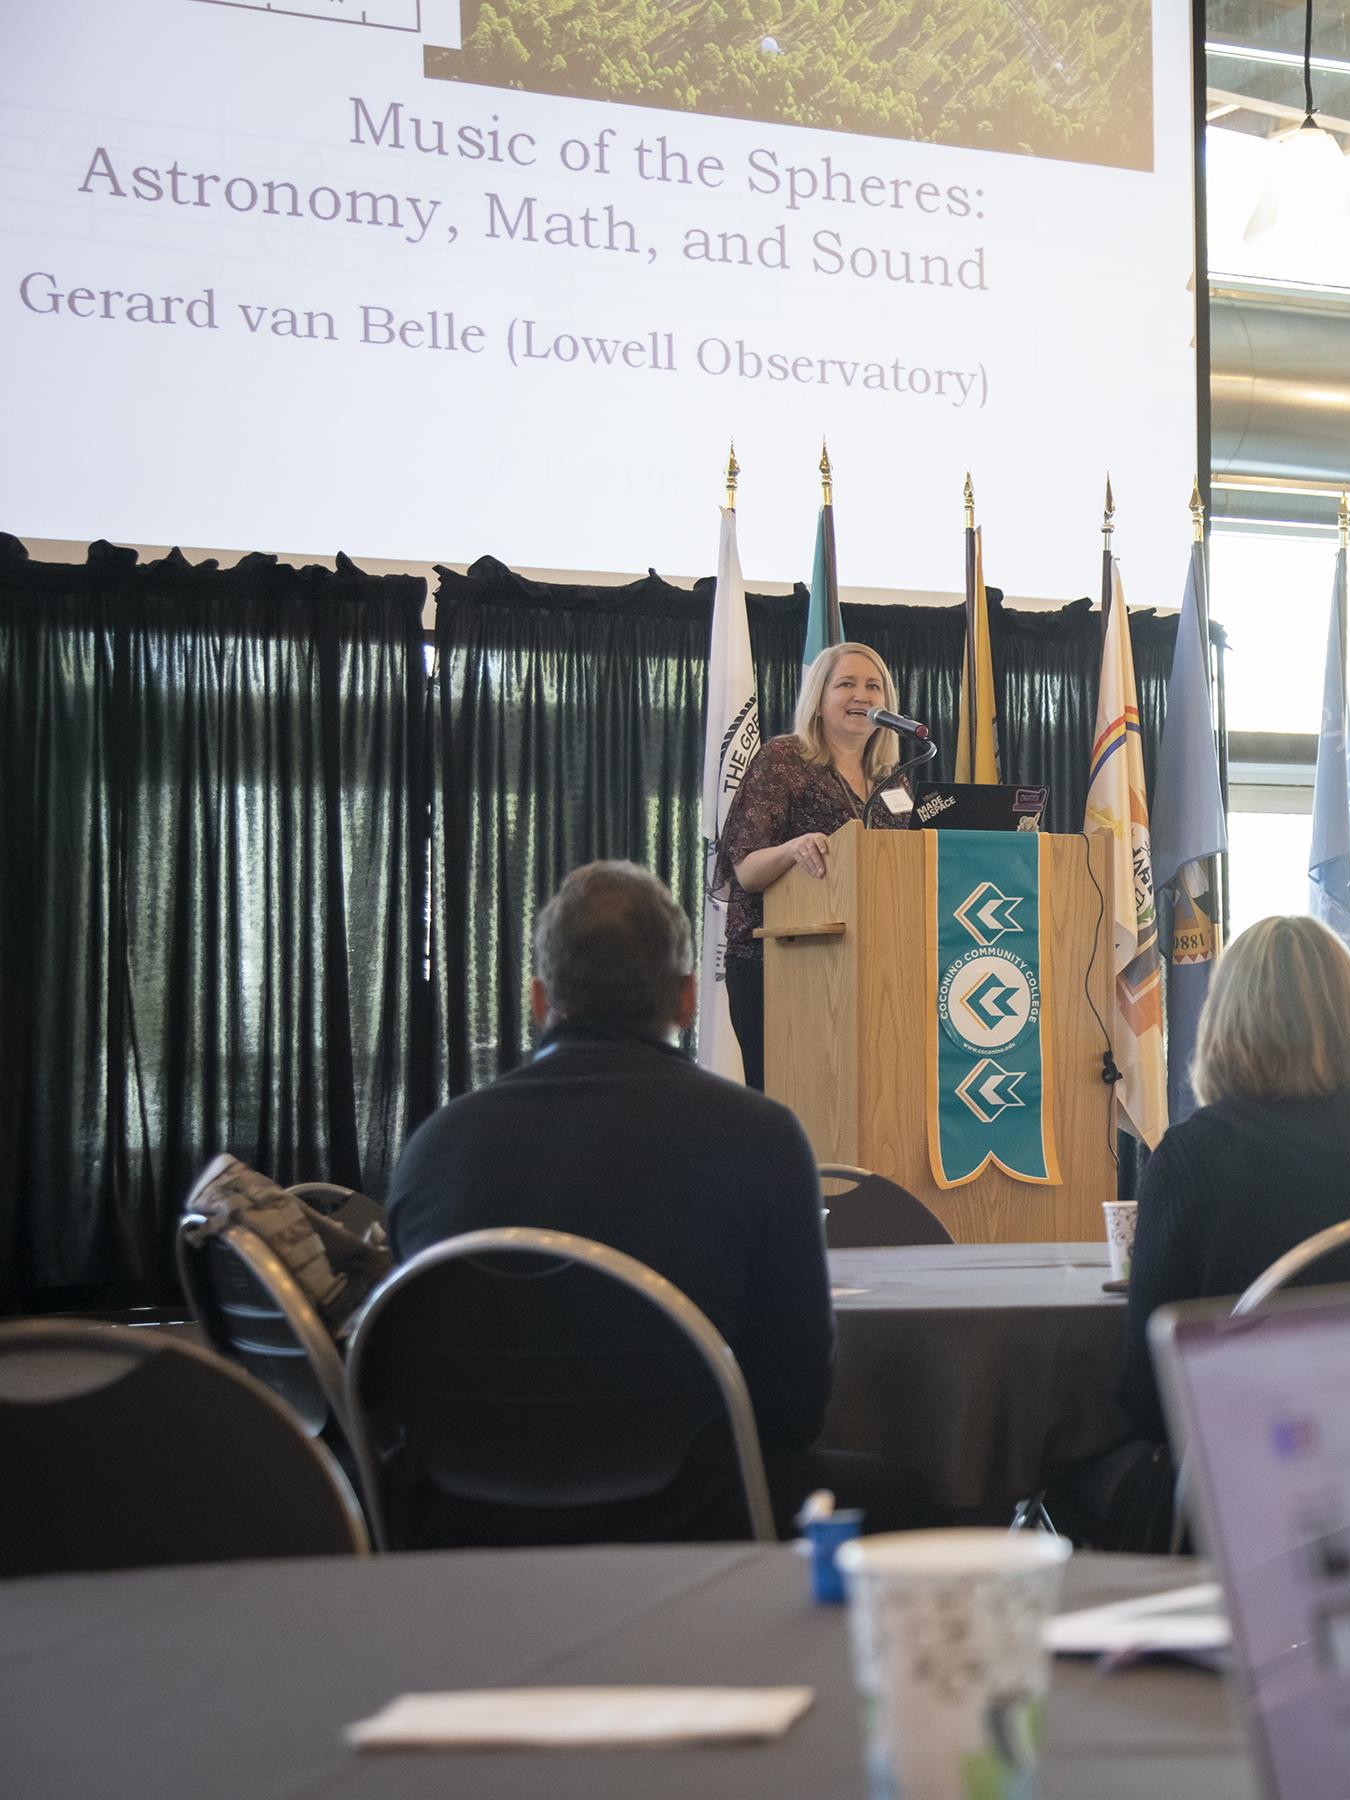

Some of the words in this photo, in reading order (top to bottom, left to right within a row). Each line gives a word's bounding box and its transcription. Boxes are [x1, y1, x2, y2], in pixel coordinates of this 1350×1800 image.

[349, 96, 537, 166] Music
[560, 129, 617, 175] of
[634, 136, 724, 188] the
[748, 148, 985, 219] Spheres:
[77, 147, 459, 243] Astronomy,
[484, 192, 657, 264] Math,
[683, 224, 790, 269] and
[812, 230, 989, 290] Sound
[19, 272, 219, 329] Gerard
[238, 304, 338, 340] van
[359, 305, 486, 353] Belle
[507, 318, 677, 371] (Lowell
[697, 337, 989, 408] Observatory)
[723, 750, 746, 793] THE
[917, 795, 943, 816] MADE
[930, 796, 957, 818] SPACE
[939, 960, 963, 1020] COCONINO
[964, 947, 1028, 969] COMMUNITY
[1025, 971, 1040, 1024] COLLEGE
